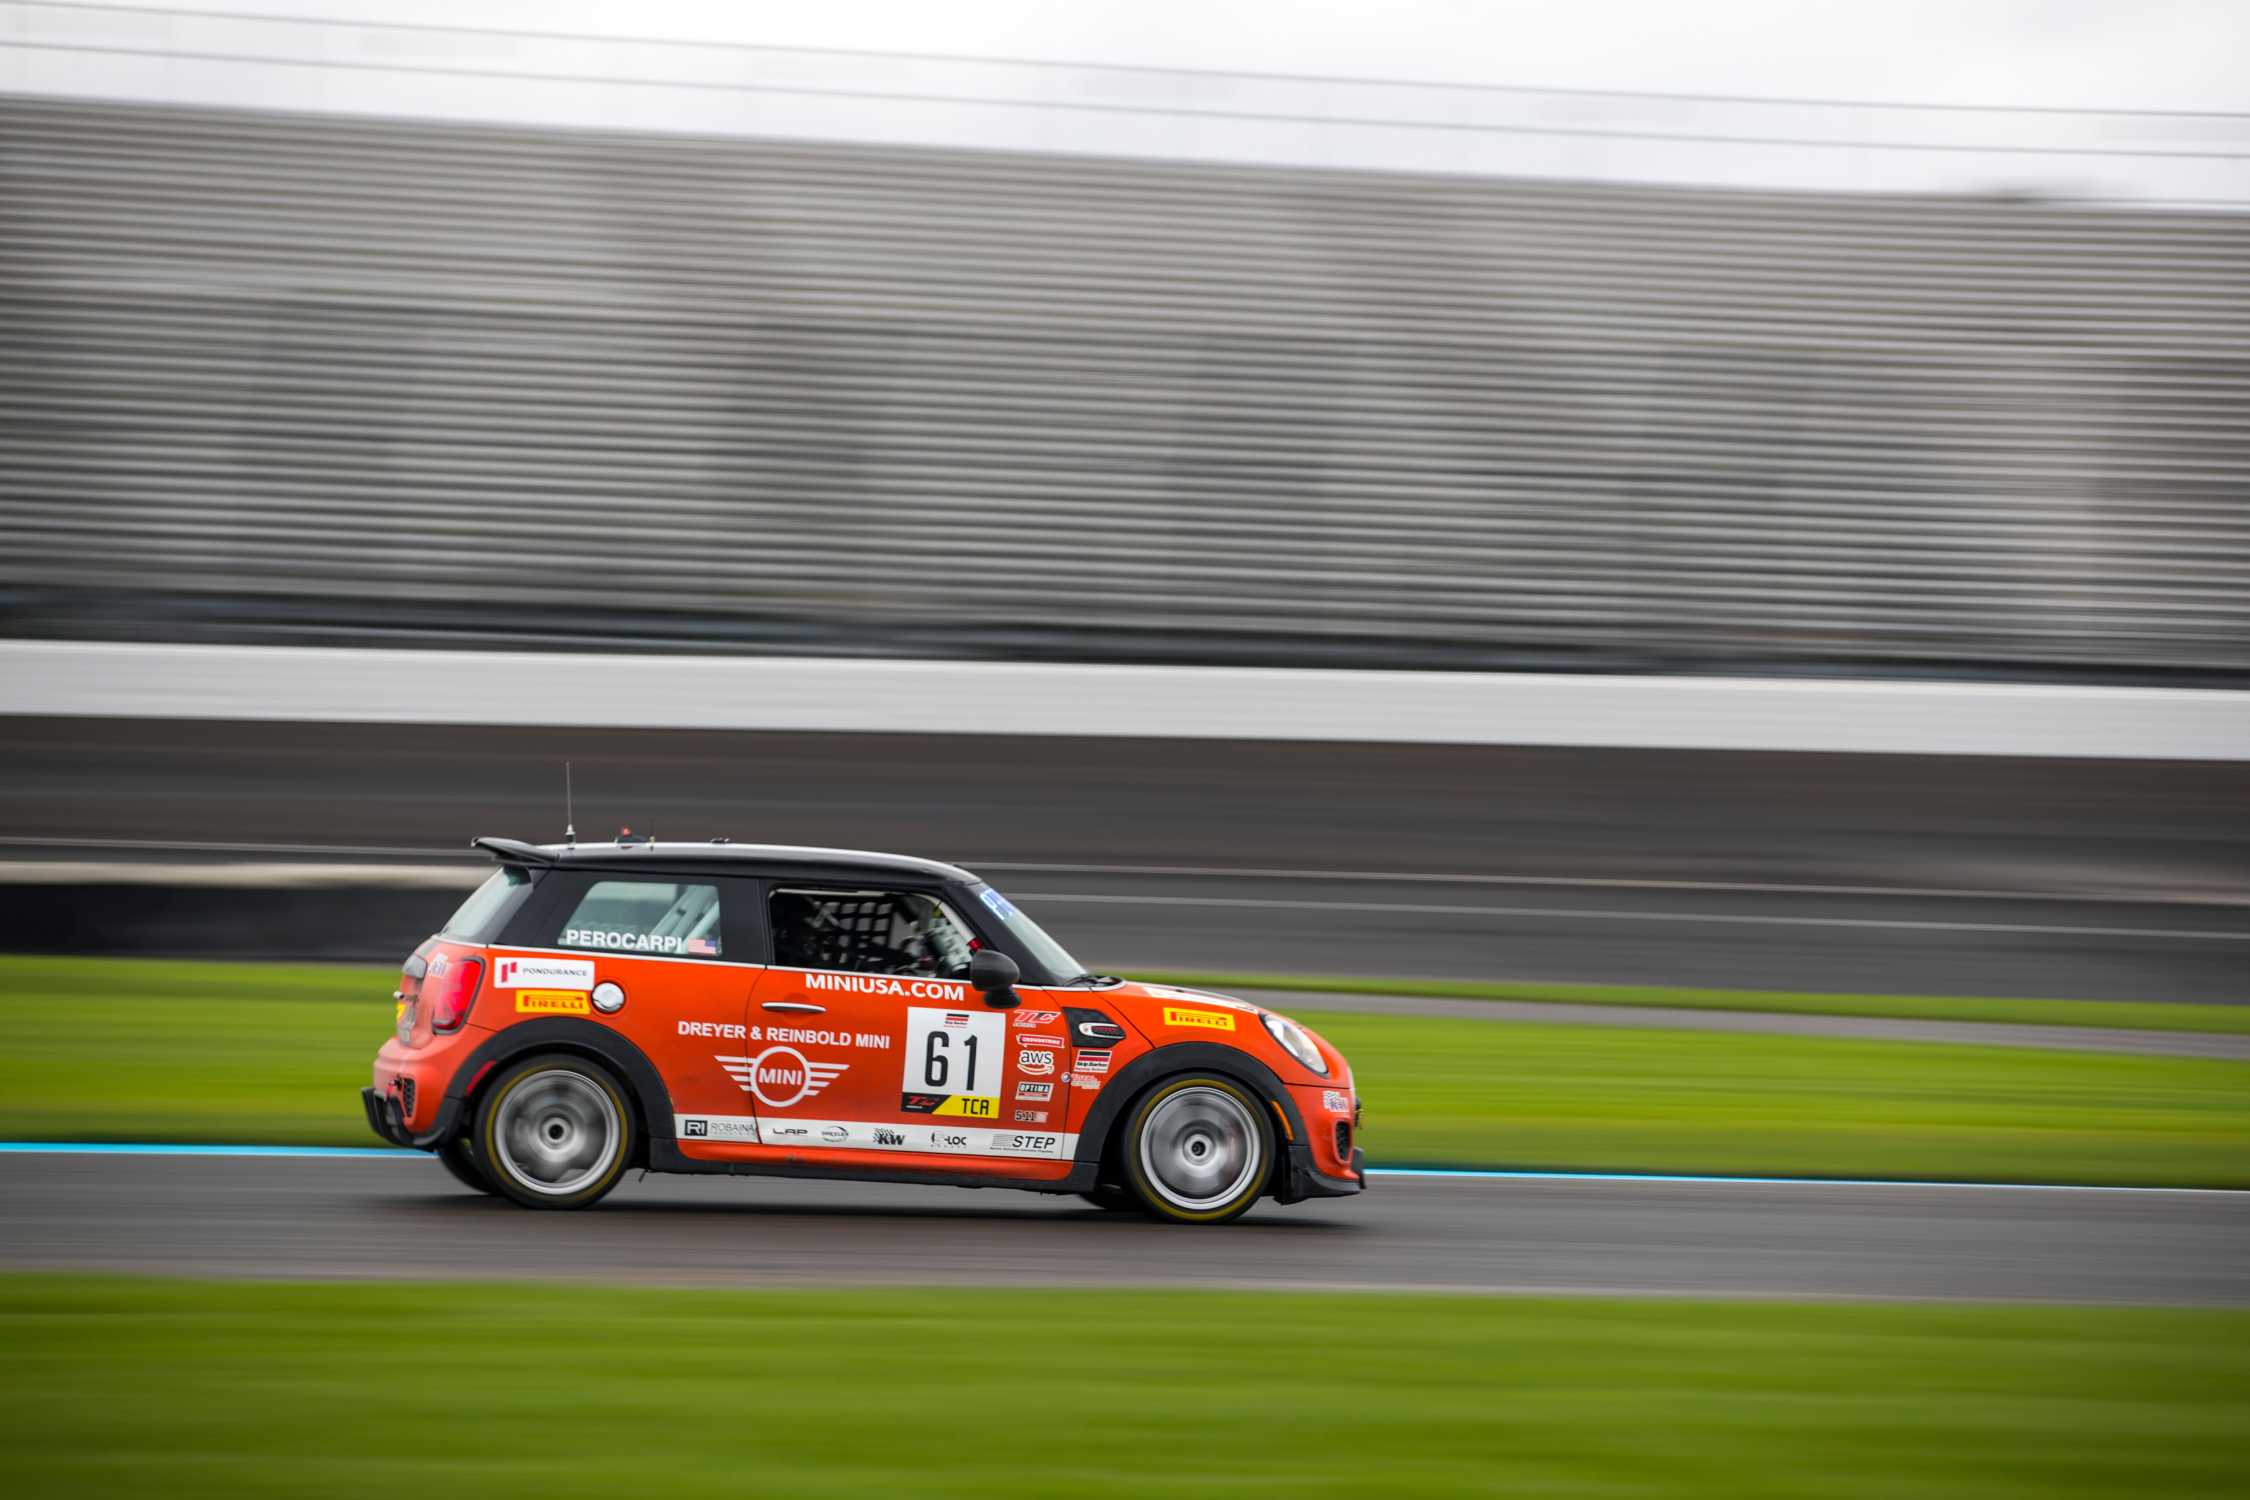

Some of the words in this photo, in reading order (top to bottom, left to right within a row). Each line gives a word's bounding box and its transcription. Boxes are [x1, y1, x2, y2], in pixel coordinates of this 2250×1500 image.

[565, 929, 683, 952] PEROCARPI
[522, 967, 587, 977] PONDURANCE
[805, 973, 965, 1001] MINIUSA.COM
[523, 995, 584, 1009] PIRELLI
[677, 1021, 746, 1040] DREYER
[750, 1026, 762, 1041] &
[767, 1027, 851, 1047] REINBOLD
[855, 1033, 890, 1049] MINI
[924, 1030, 978, 1092] 61
[1020, 1050, 1053, 1065] aws
[758, 1067, 803, 1086] MINI
[1019, 1083, 1049, 1093] OPTIMA
[961, 1097, 990, 1116] TCA
[1011, 1135, 1056, 1150] STEP
